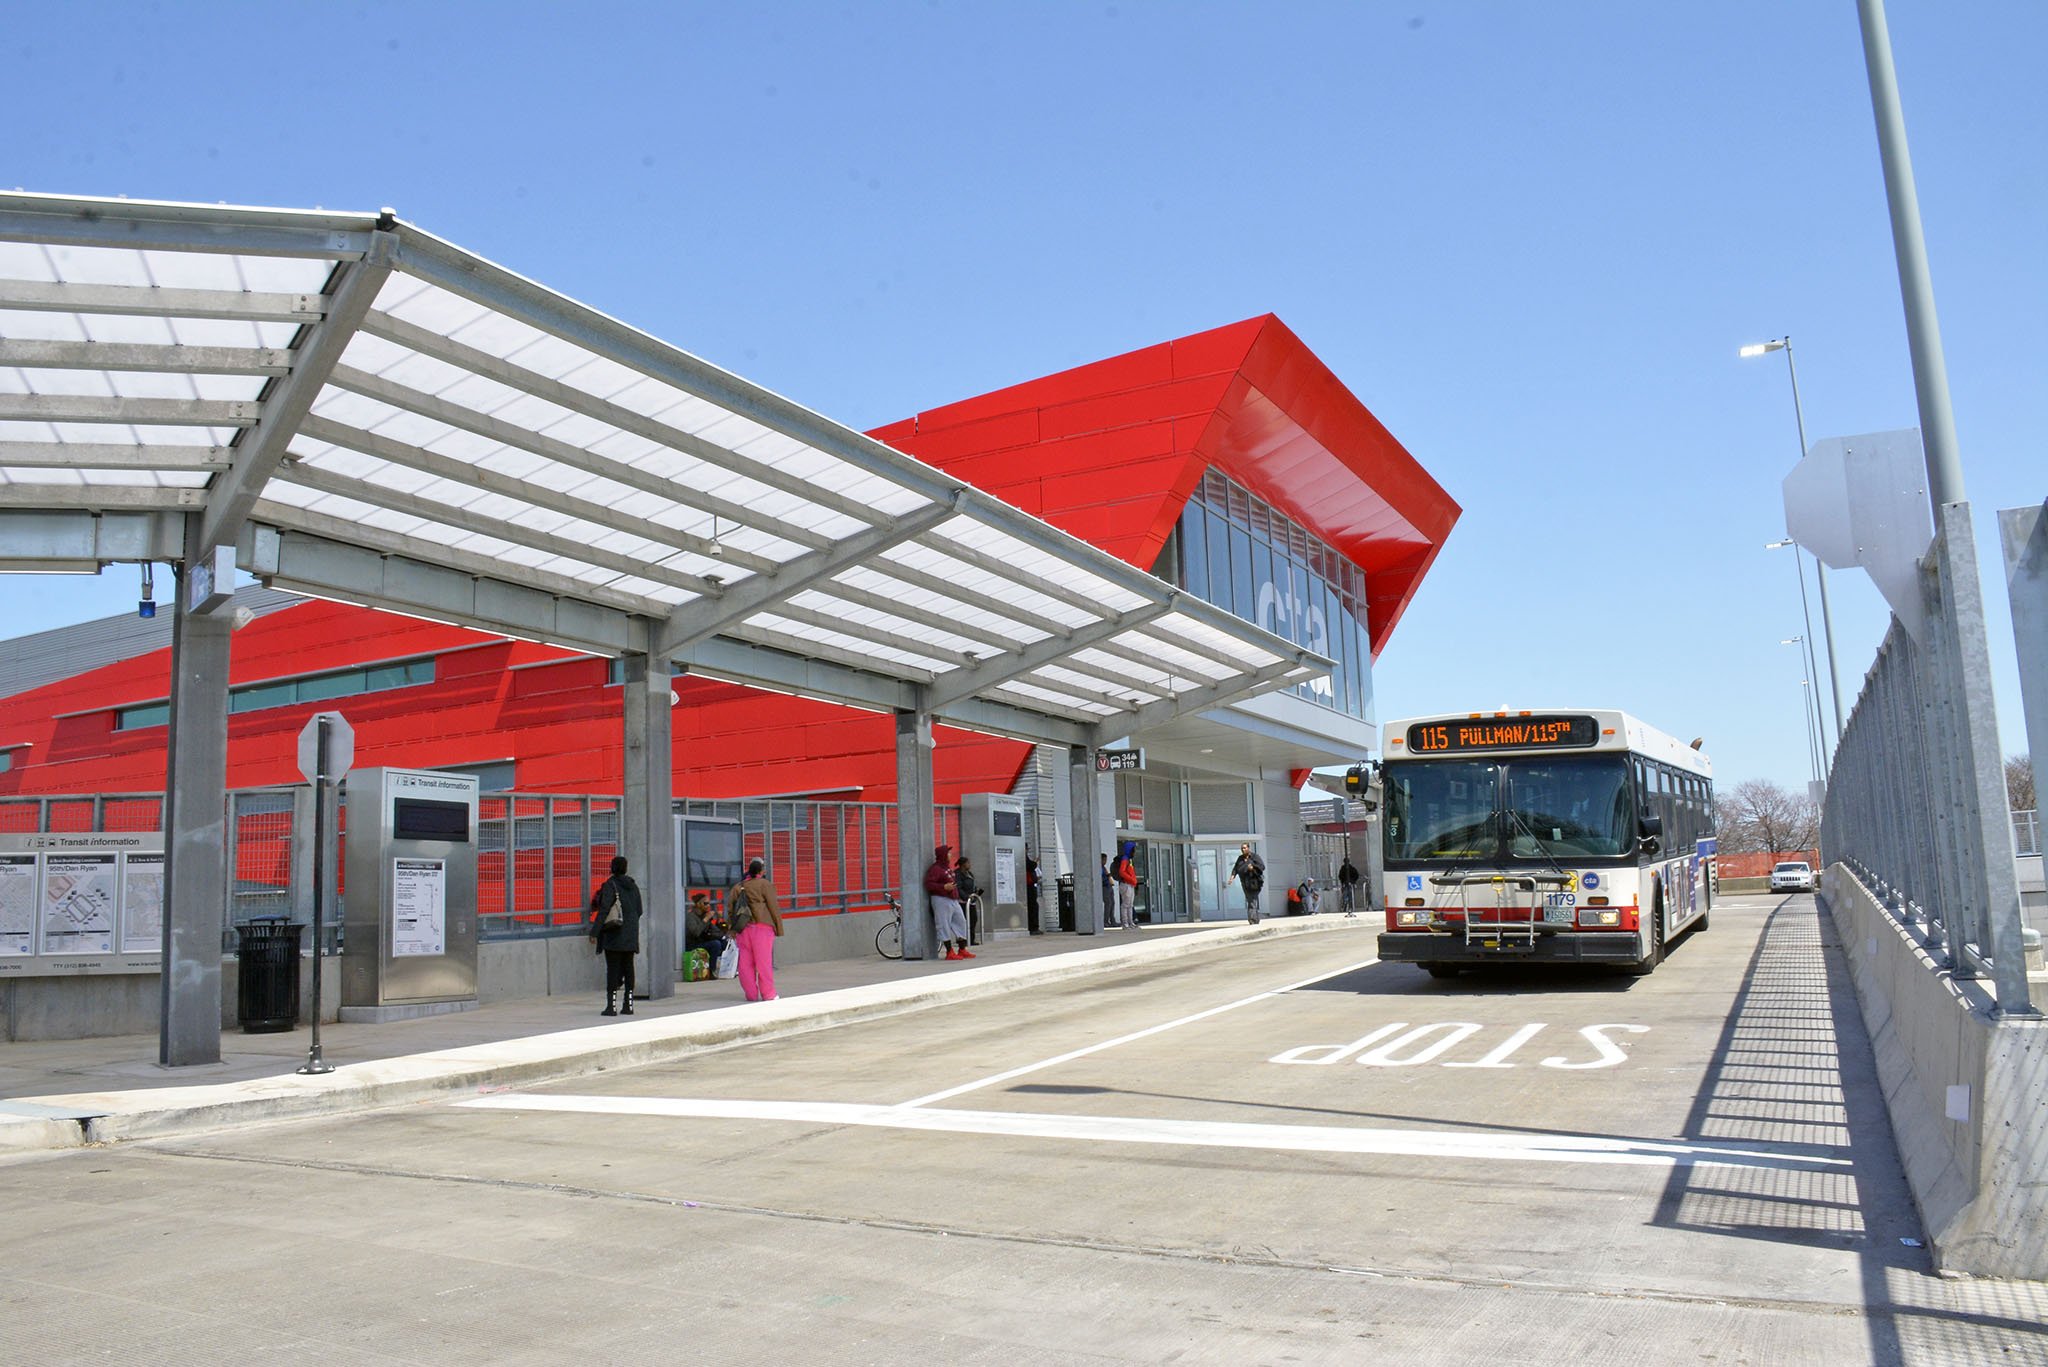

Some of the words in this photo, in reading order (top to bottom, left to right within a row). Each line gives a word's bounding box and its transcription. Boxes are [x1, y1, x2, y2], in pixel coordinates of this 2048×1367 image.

[1421, 727, 1449, 750] 115
[1121, 753, 1131, 761] 34
[1100, 759, 1106, 768] V
[1122, 760, 1135, 768] 119
[418, 779, 437, 787] Transit
[438, 780, 470, 790] information
[60, 838, 88, 846] Transit
[91, 837, 139, 846] information
[80, 865, 97, 873] Ryan
[1546, 893, 1576, 906] 1179
[1268, 1022, 1651, 1070] STOP
